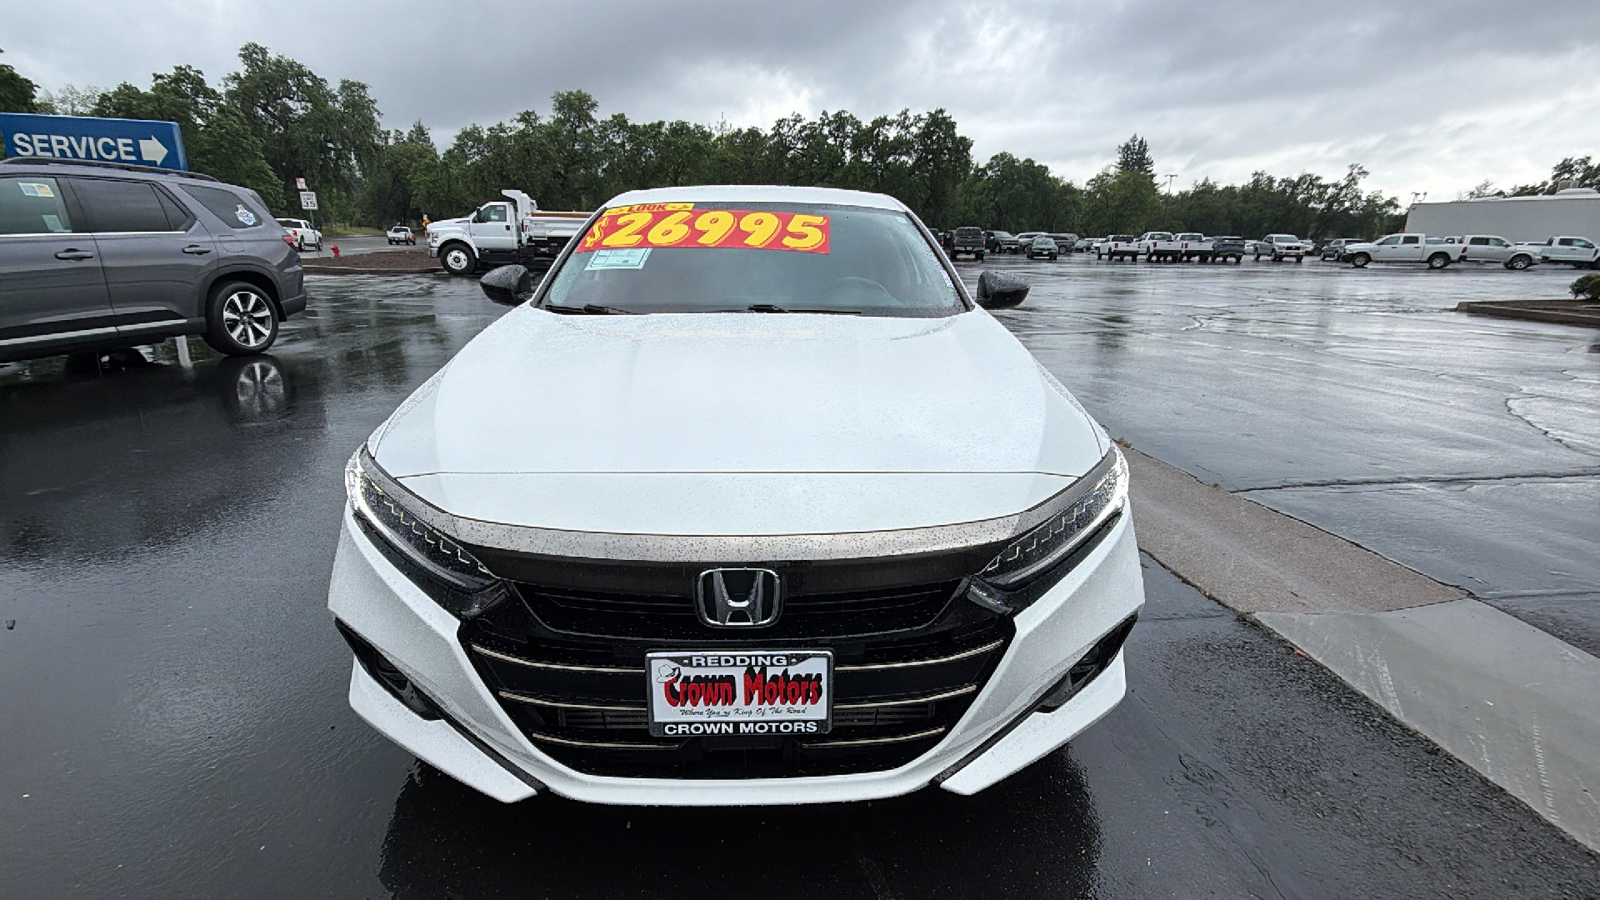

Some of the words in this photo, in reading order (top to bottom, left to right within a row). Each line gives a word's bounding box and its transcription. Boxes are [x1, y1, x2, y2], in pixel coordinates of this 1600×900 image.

[13, 133, 138, 161] SERVICE
[627, 203, 668, 213] LOOK
[584, 211, 827, 249] $26995
[692, 656, 788, 667] REDDING
[664, 668, 737, 707] Crown
[743, 667, 823, 706] Motors
[680, 708, 704, 716] Where
[733, 708, 753, 717] King
[756, 708, 767, 717] Of
[769, 707, 783, 715] The
[786, 706, 807, 715] Road
[664, 722, 734, 735] CROWN
[739, 721, 818, 734] MOTORS
